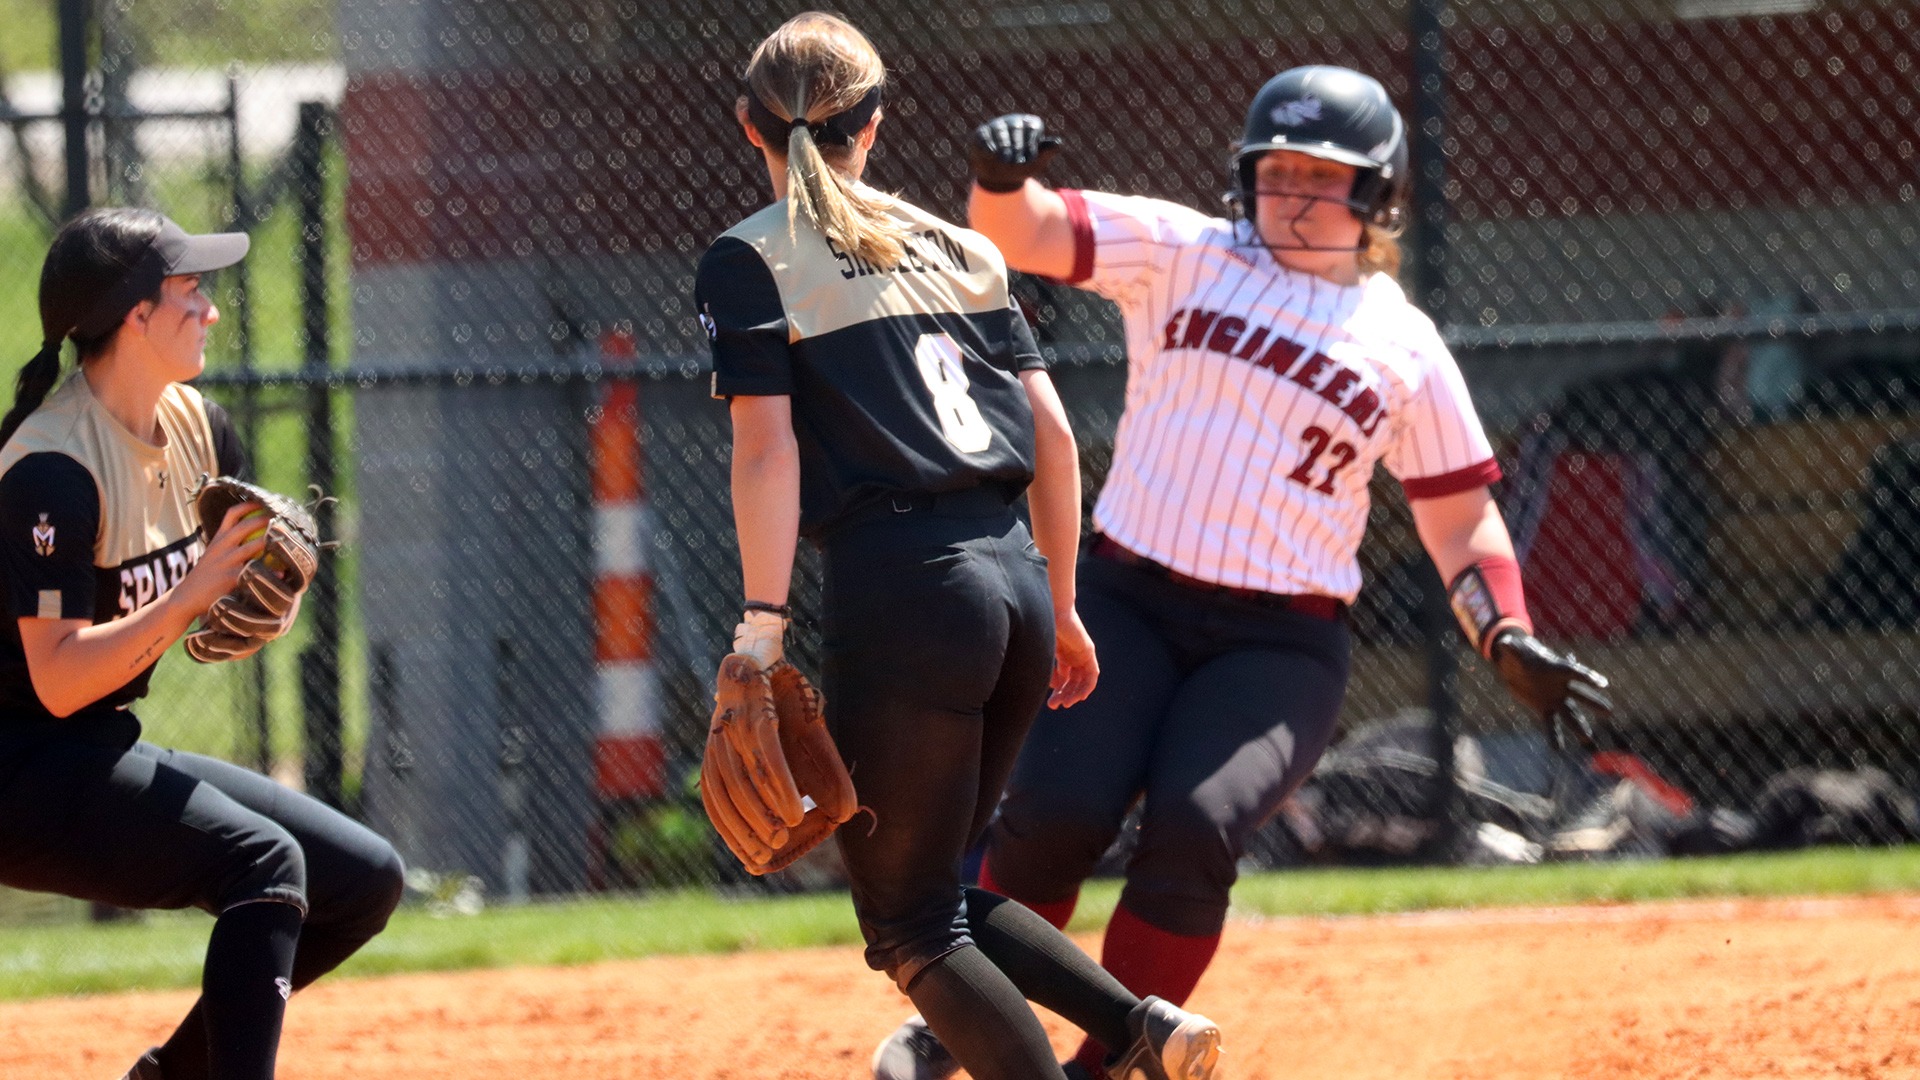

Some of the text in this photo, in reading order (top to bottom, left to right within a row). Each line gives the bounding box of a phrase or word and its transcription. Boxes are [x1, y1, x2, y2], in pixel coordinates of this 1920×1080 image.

[914, 332, 992, 454] 8
[1163, 308, 1388, 438] ENGINEERS
[1286, 425, 1357, 496] 22
